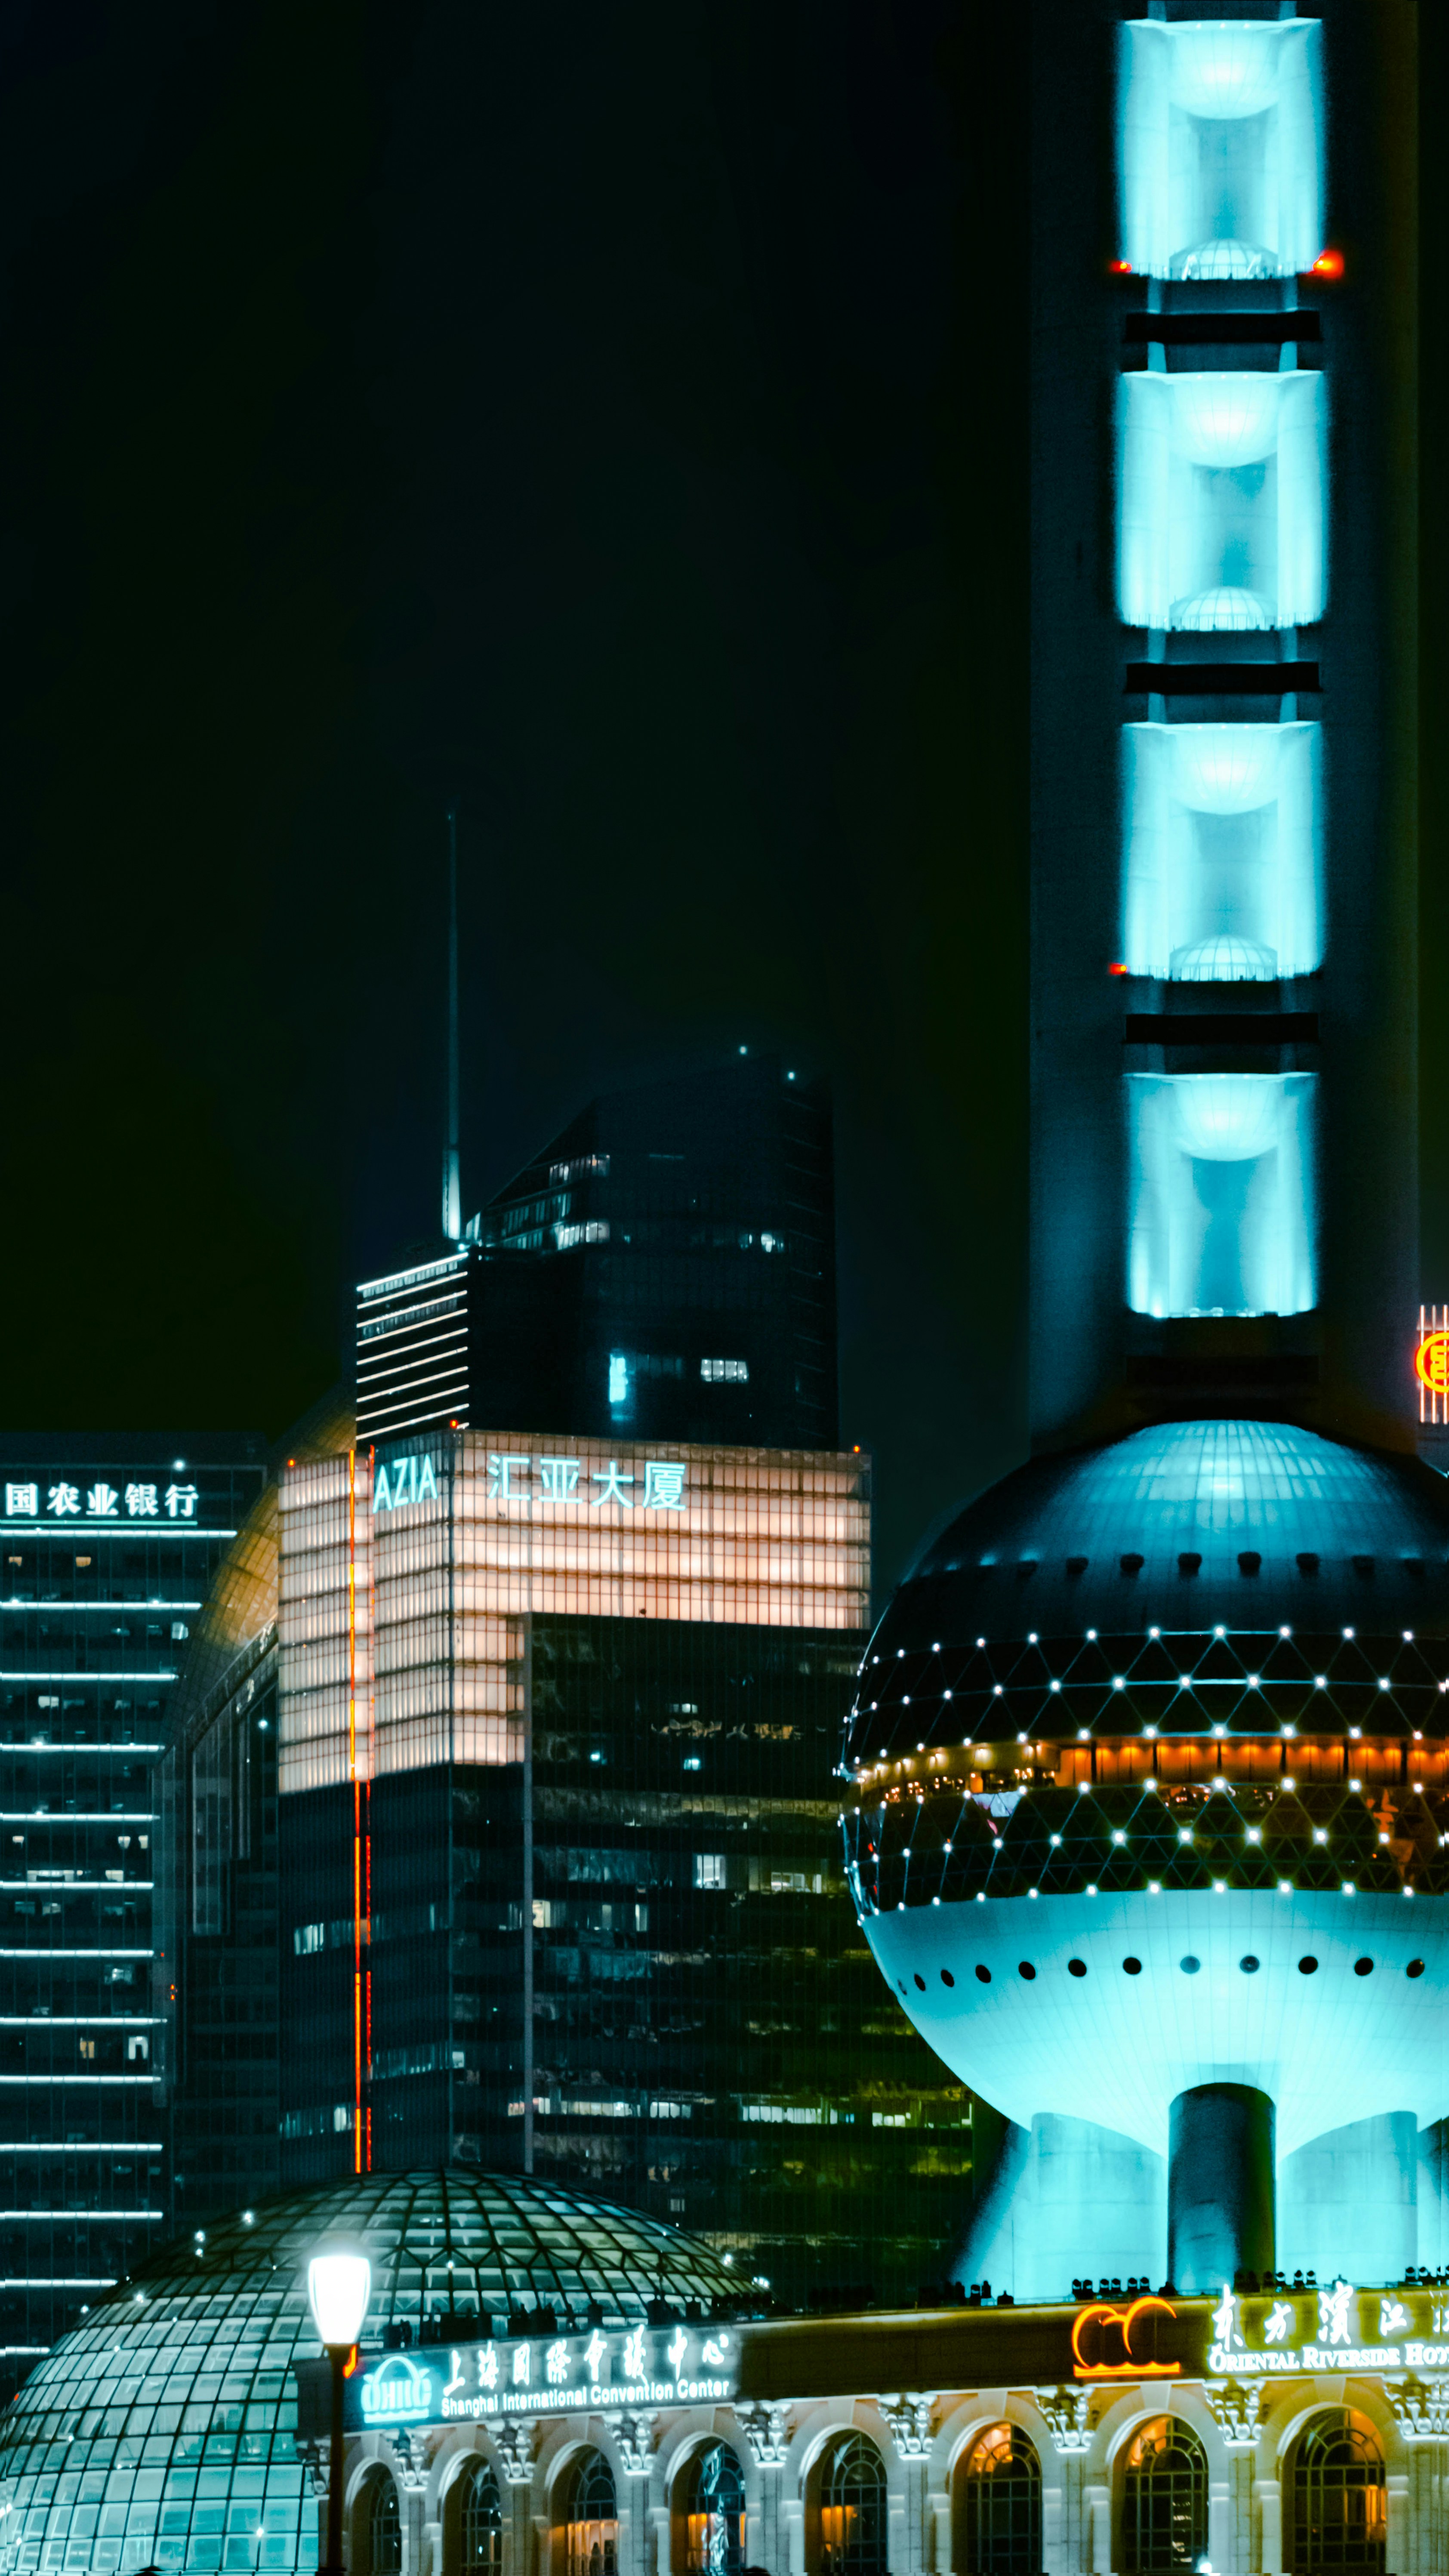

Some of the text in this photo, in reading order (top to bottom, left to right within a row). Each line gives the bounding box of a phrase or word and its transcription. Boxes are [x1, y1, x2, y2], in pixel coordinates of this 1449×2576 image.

[6, 1482, 199, 1517] 国农业银行
[372, 1455, 438, 1514] AZIA
[487, 1454, 687, 1513] 汇亚大厦
[1209, 2349, 1300, 2372] ORIENTAL
[1302, 2345, 1401, 2369] RIVERSIDE
[441, 2379, 730, 2418] Shanghai International Convention Center
